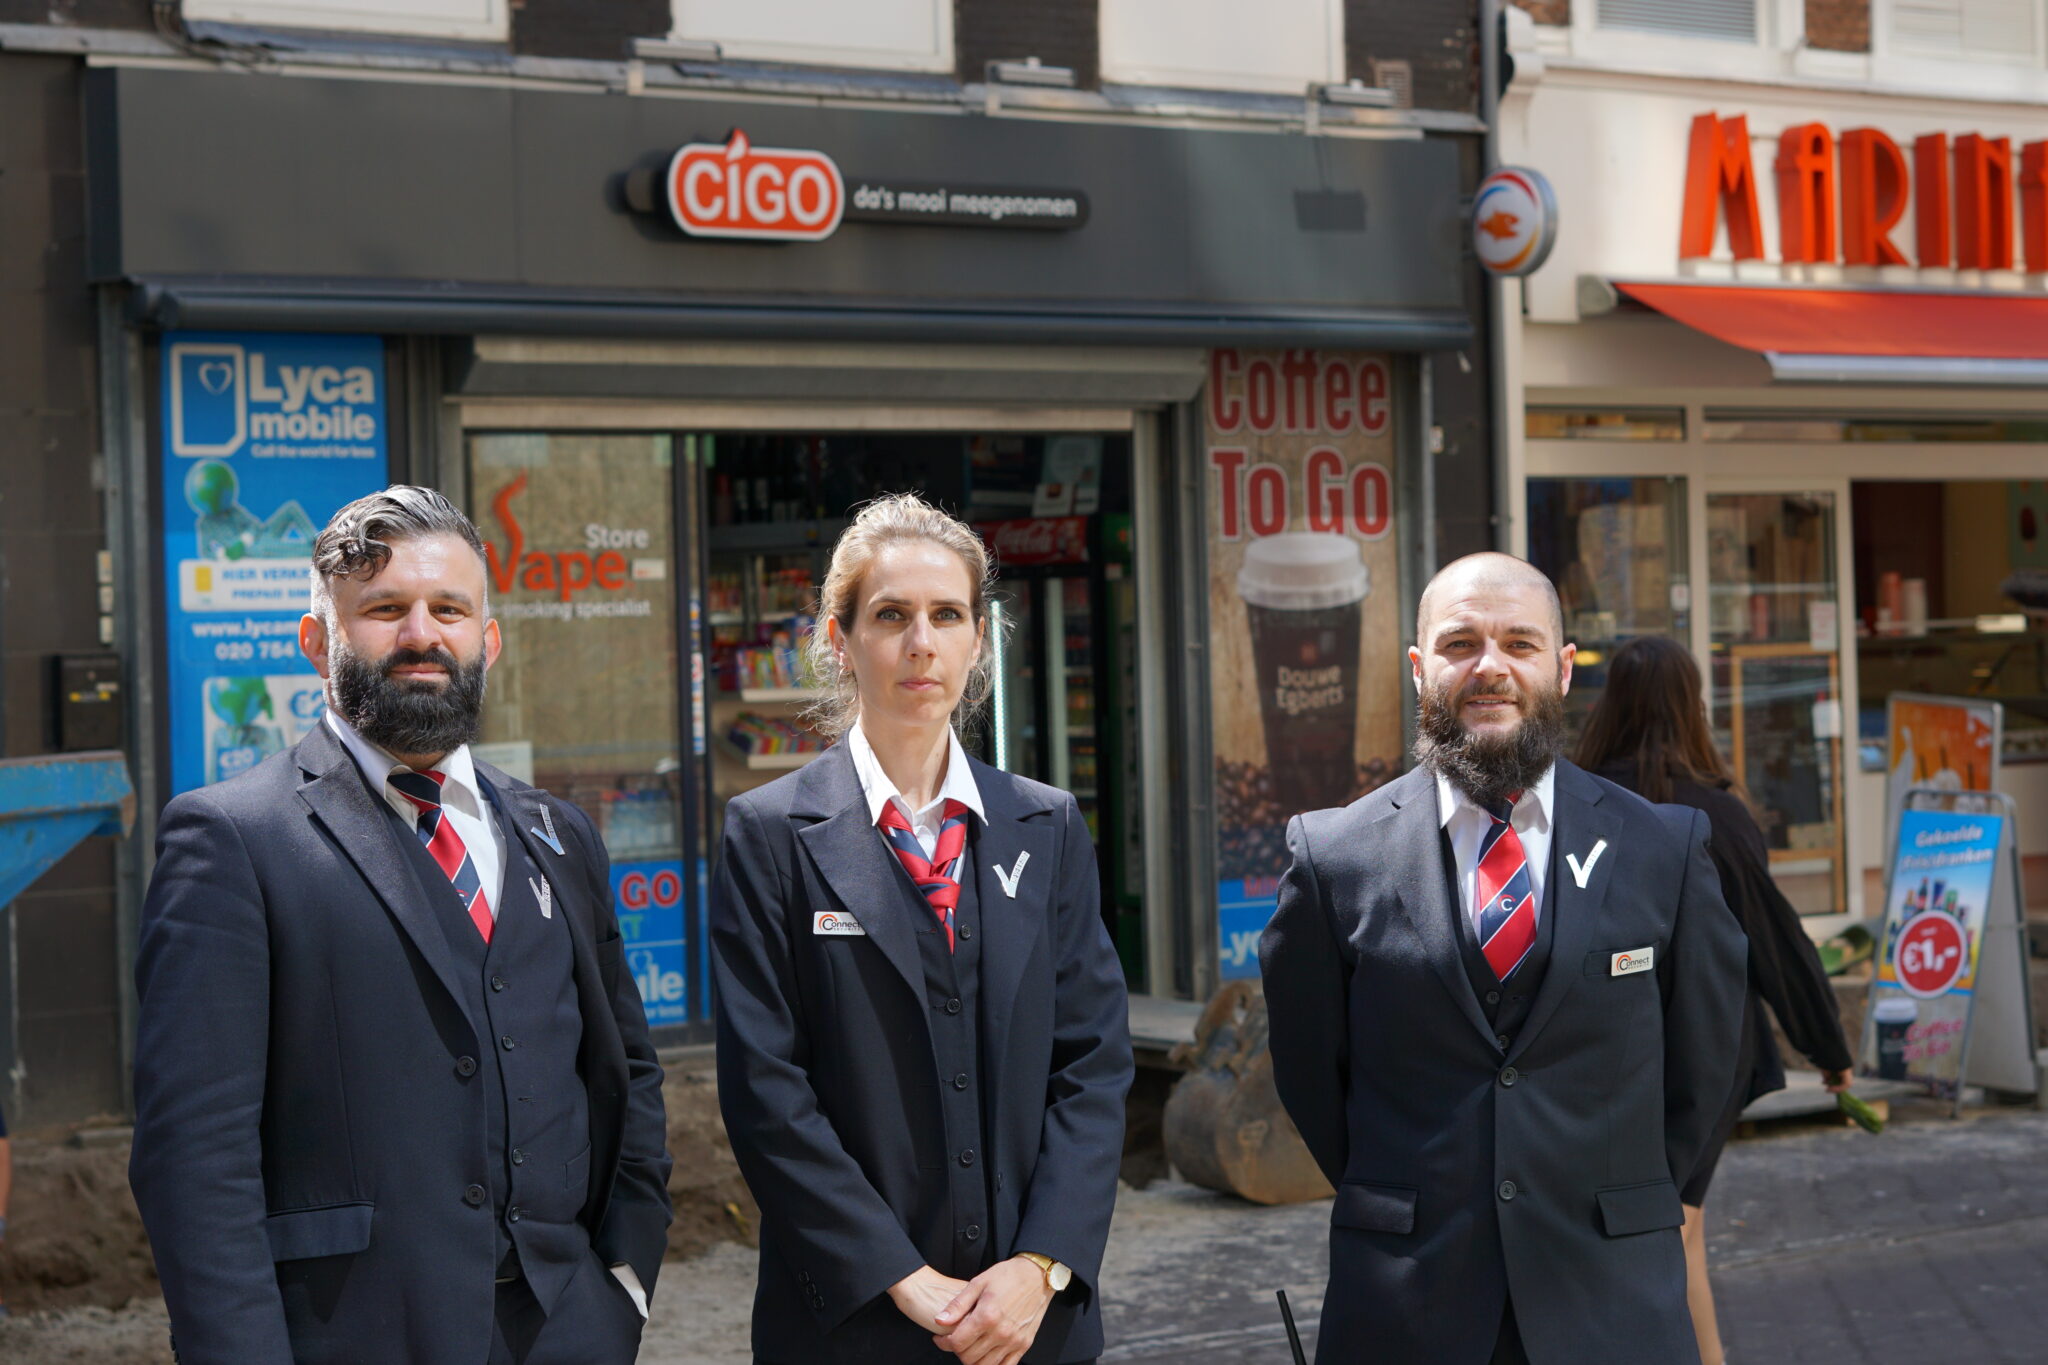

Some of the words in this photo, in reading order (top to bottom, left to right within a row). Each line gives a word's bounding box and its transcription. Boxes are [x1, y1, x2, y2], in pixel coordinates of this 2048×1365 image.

[854, 184, 895, 211] da's
[898, 187, 947, 213] mooi
[950, 193, 1077, 220] meegenomen
[249, 352, 376, 413] Lyca
[1209, 347, 1391, 435] Coffee
[250, 405, 376, 441] mobile
[1208, 448, 1289, 541] To
[1304, 446, 1393, 540] Go
[483, 498, 627, 602] Vape
[585, 523, 649, 549] Store
[215, 642, 254, 661] 020
[620, 870, 682, 911] GO
[1620, 956, 1650, 971] Connect
